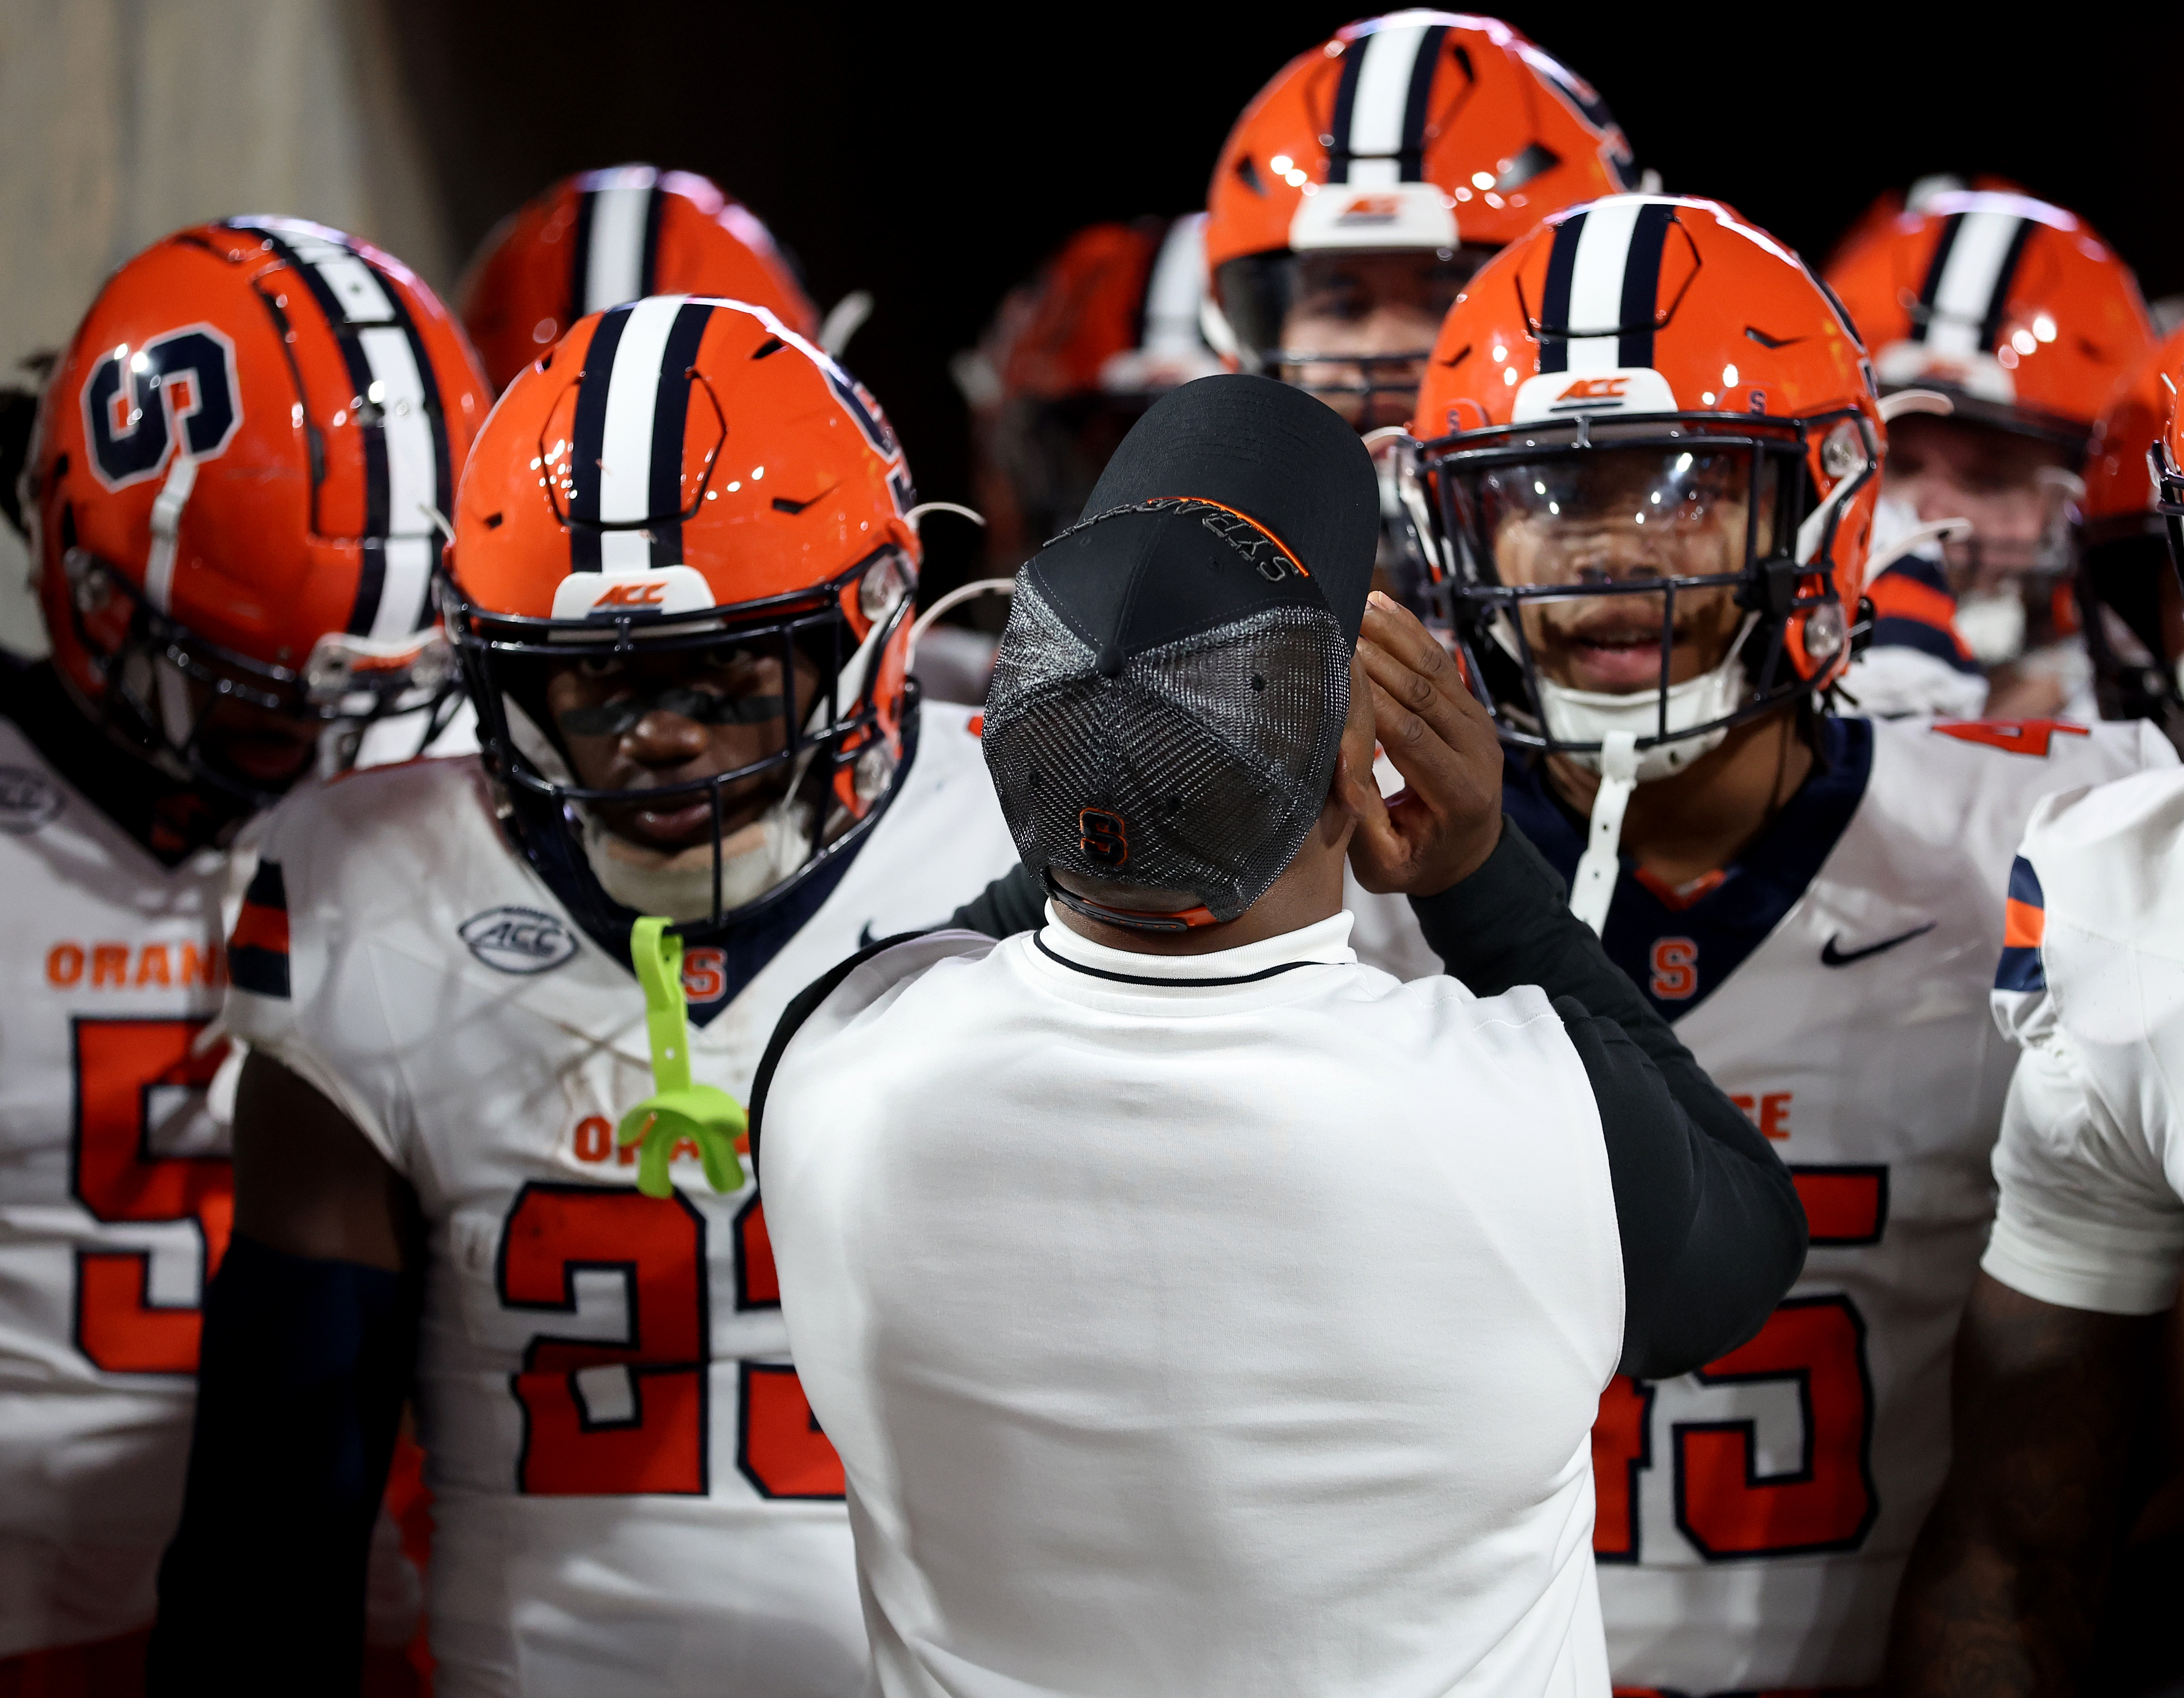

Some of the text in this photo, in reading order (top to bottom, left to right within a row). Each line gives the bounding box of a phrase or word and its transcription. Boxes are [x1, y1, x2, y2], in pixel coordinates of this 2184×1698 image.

[81, 322, 243, 493] S
[1556, 378, 1630, 401] ACC
[592, 582, 668, 607] ACC
[1079, 806, 1128, 866] S
[471, 923, 561, 957] ACC
[683, 947, 728, 1003] S
[1649, 936, 1699, 1001] S
